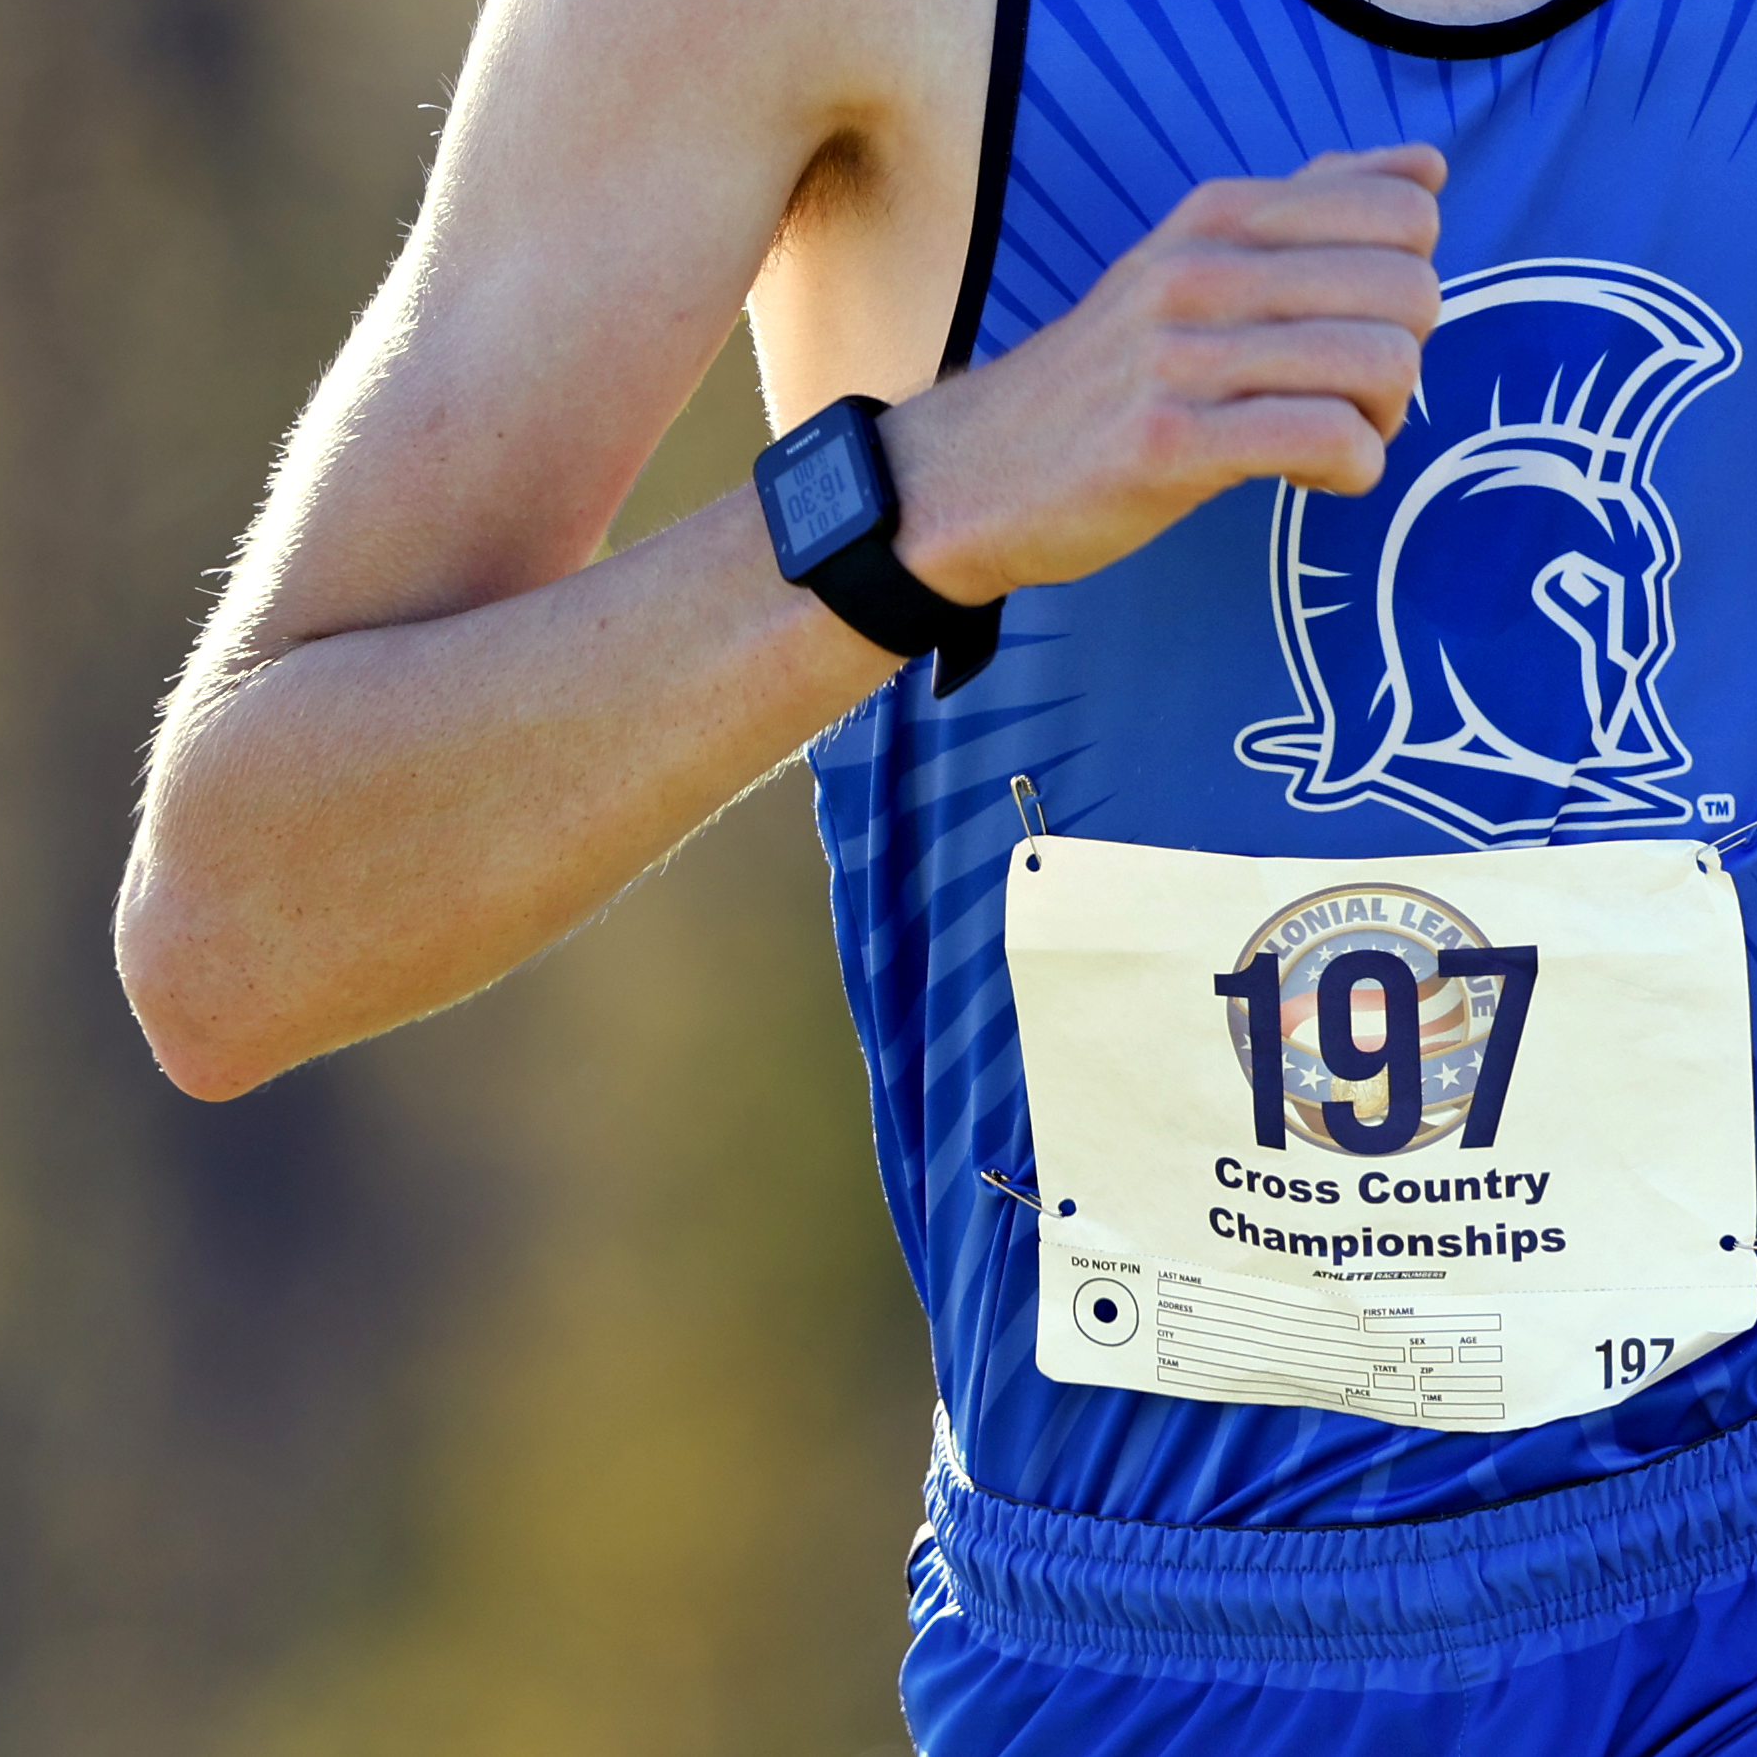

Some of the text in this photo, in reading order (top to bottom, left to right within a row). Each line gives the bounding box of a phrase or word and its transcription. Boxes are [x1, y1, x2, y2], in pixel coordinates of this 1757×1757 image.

[785, 427, 821, 457] GARMIN
[787, 466, 846, 524] 16:30
[1704, 800, 1729, 817] TM
[1263, 897, 1498, 1018] LONIAL LEAUE
[1213, 944, 1539, 1156] 197
[1214, 1156, 1551, 1205] Cross Country
[1208, 1206, 1567, 1266] Championships
[1071, 1256, 1141, 1274] DO NOT PIN
[1158, 1270, 1202, 1284] LAST NAME
[1312, 1270, 1445, 1281] ATHLETE RACE NUMBERS
[1157, 1299, 1194, 1313] ADDRESS
[1363, 1307, 1415, 1316] FIRST NAME
[1157, 1329, 1174, 1339] CITY
[1409, 1337, 1426, 1345] SEX
[1459, 1336, 1477, 1344] AGE
[1157, 1356, 1179, 1368] TEAM
[1373, 1364, 1398, 1373] STATE
[1595, 1337, 1674, 1390] 197
[1345, 1387, 1371, 1397] PLACE
[1422, 1394, 1443, 1402] TIME
